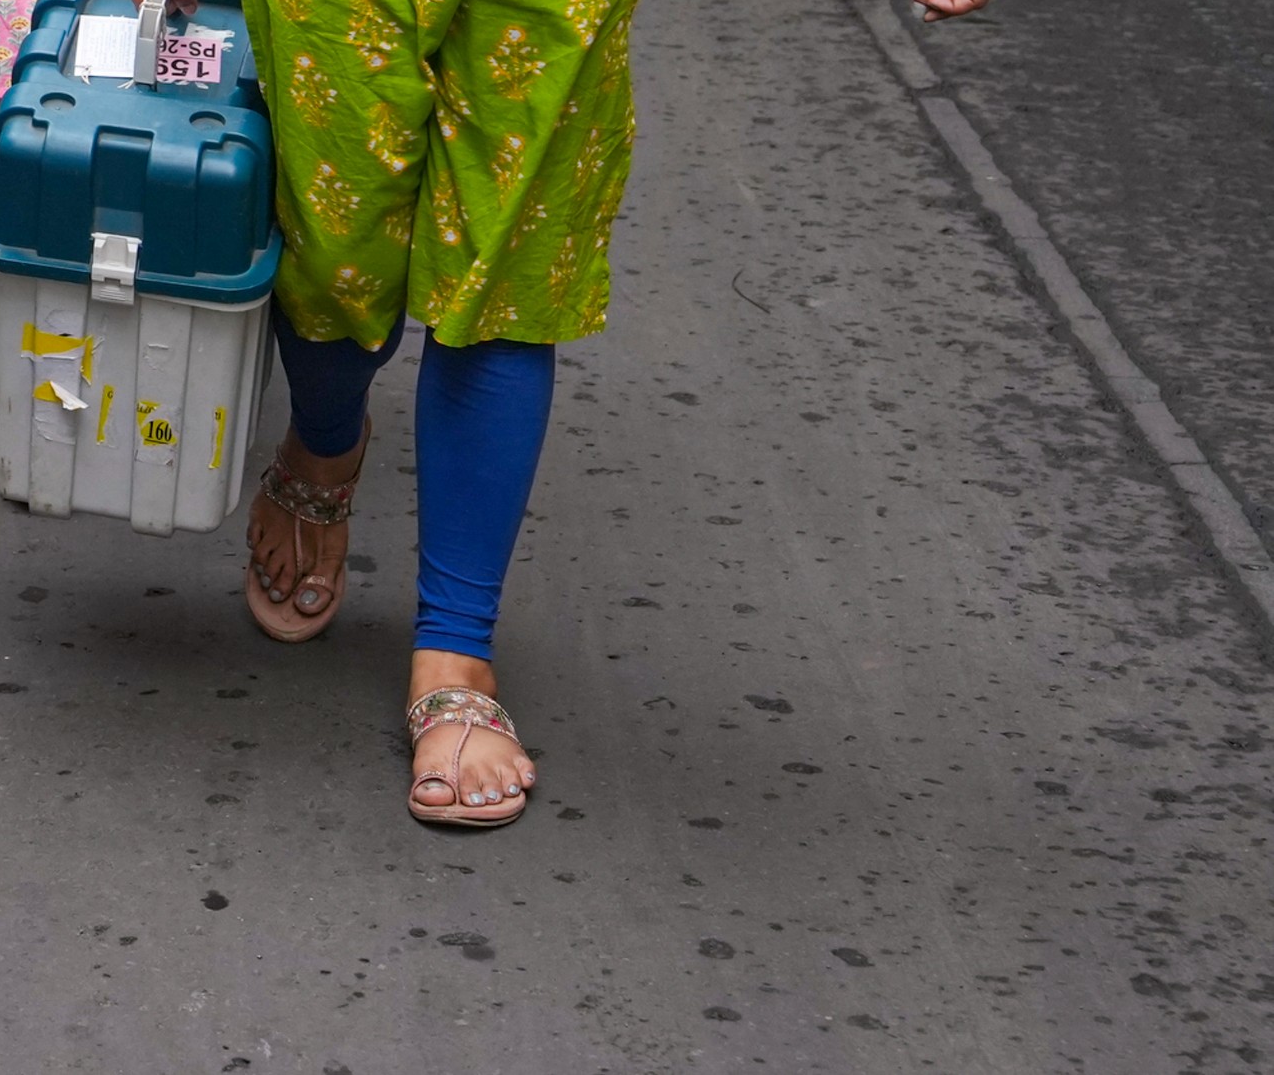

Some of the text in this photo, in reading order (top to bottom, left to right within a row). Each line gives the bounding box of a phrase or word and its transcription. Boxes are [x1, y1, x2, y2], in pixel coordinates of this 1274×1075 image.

[159, 39, 216, 58] PS-26
[157, 59, 210, 78] 159
[147, 420, 172, 442] 160
